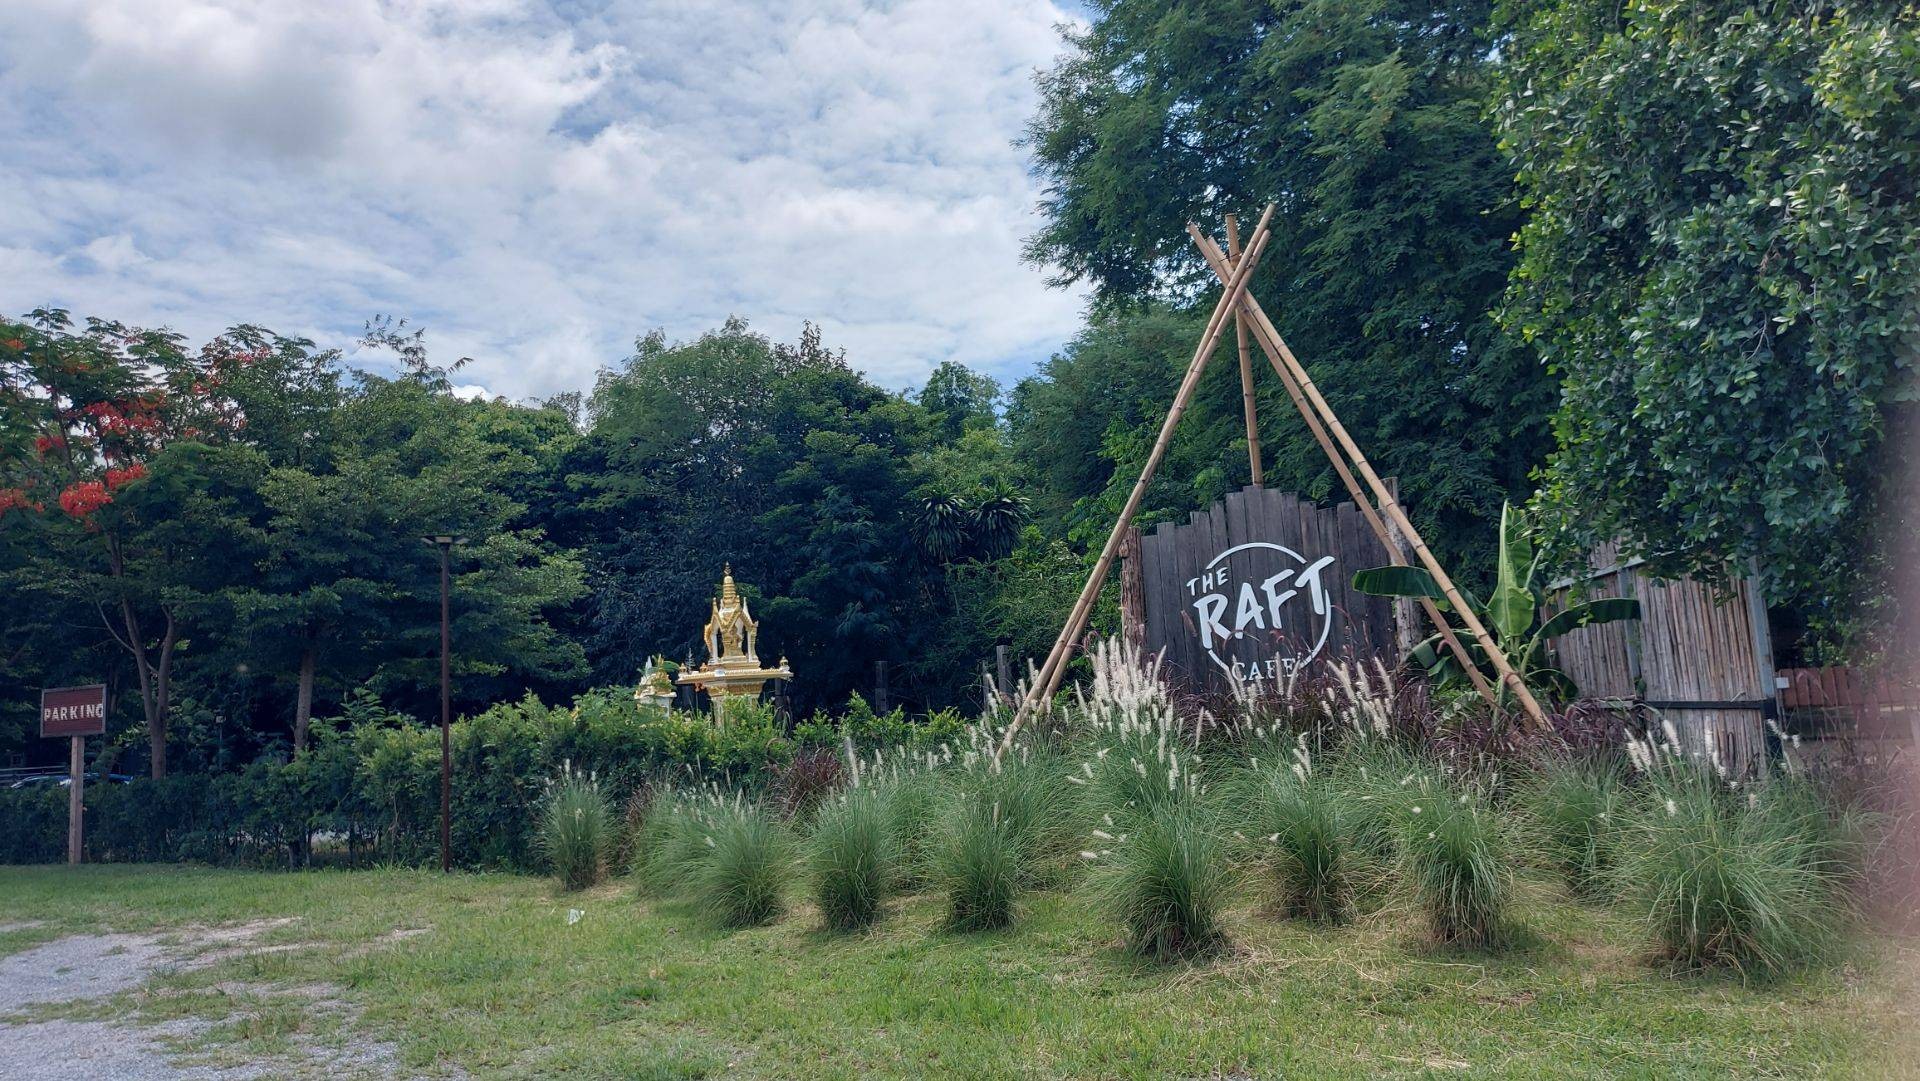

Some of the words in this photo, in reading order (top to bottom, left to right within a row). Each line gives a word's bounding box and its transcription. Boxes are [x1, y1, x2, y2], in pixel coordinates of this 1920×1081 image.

[1186, 567, 1228, 596] THE
[1193, 556, 1335, 649] RAFT
[44, 703, 104, 721] PARKING
